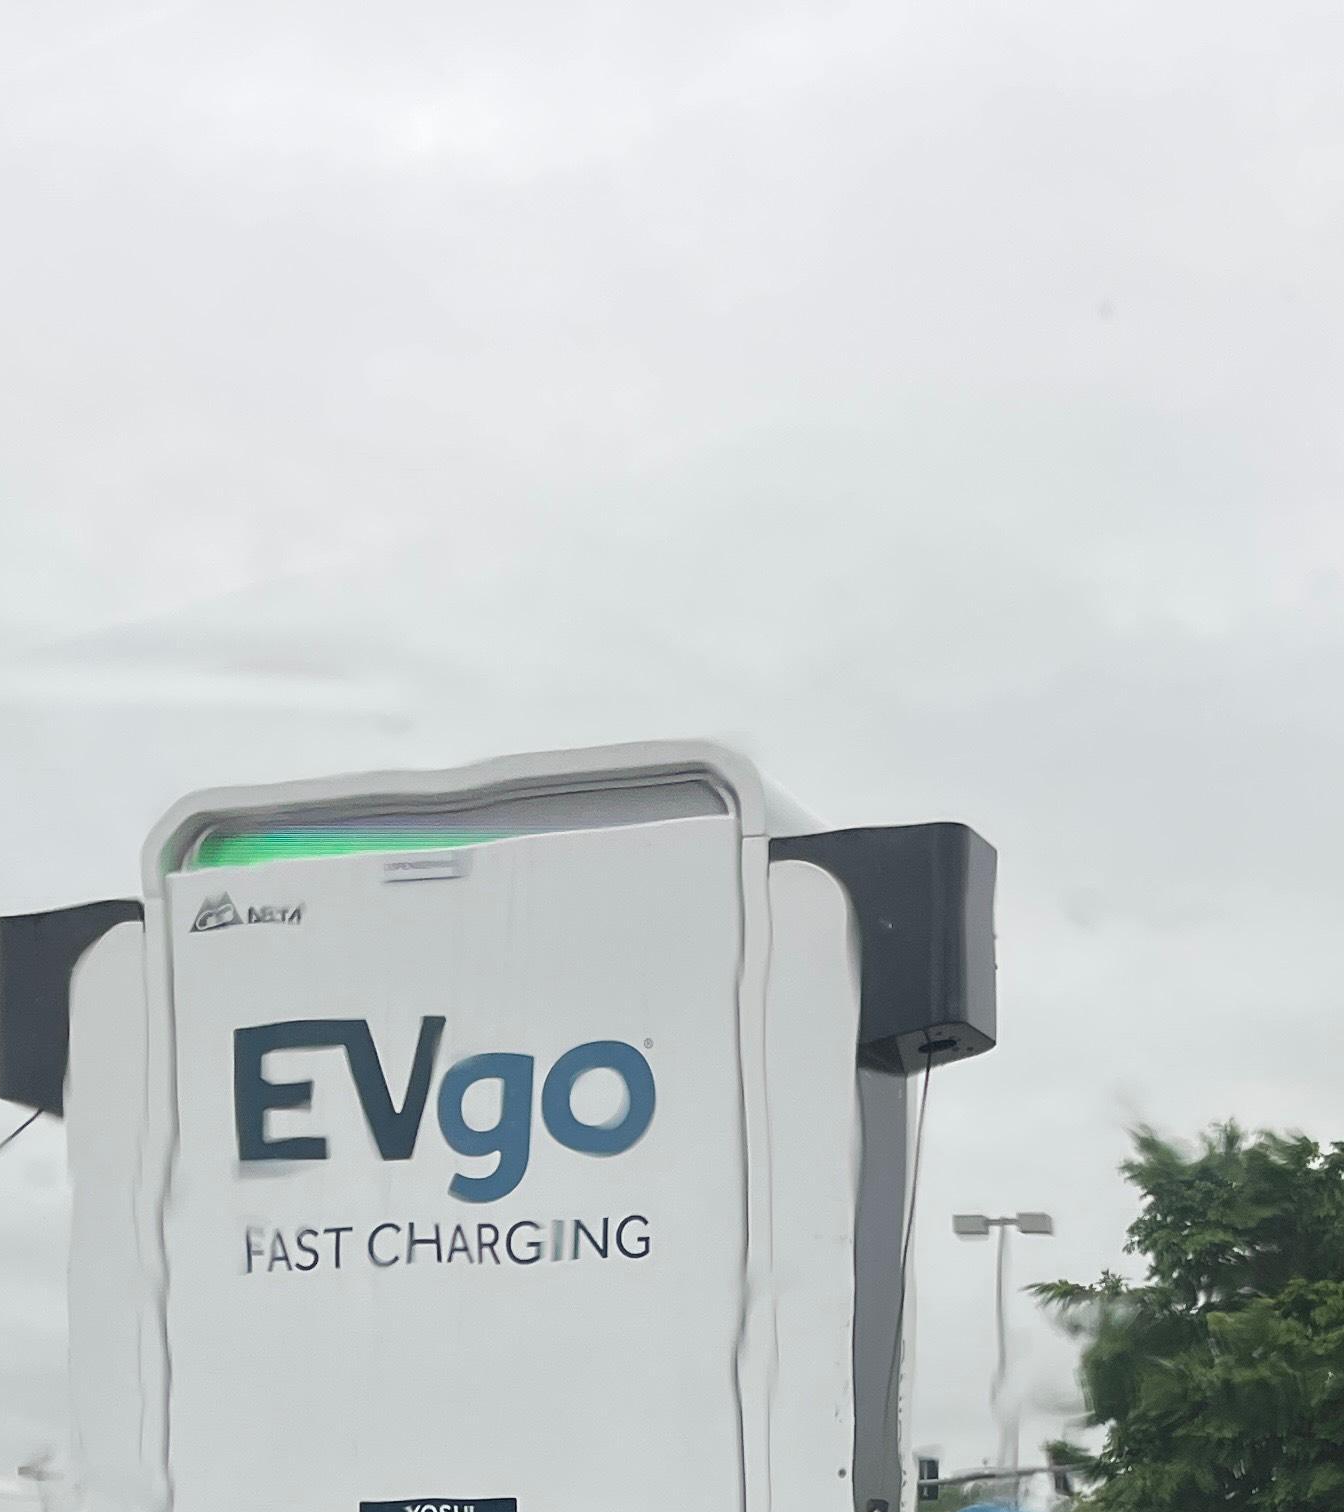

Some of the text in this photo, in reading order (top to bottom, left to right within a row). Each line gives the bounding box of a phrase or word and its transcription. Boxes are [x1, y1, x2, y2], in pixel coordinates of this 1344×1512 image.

[234, 1015, 656, 1204] EVgo
[245, 1214, 652, 1275] FAST CHARGING
